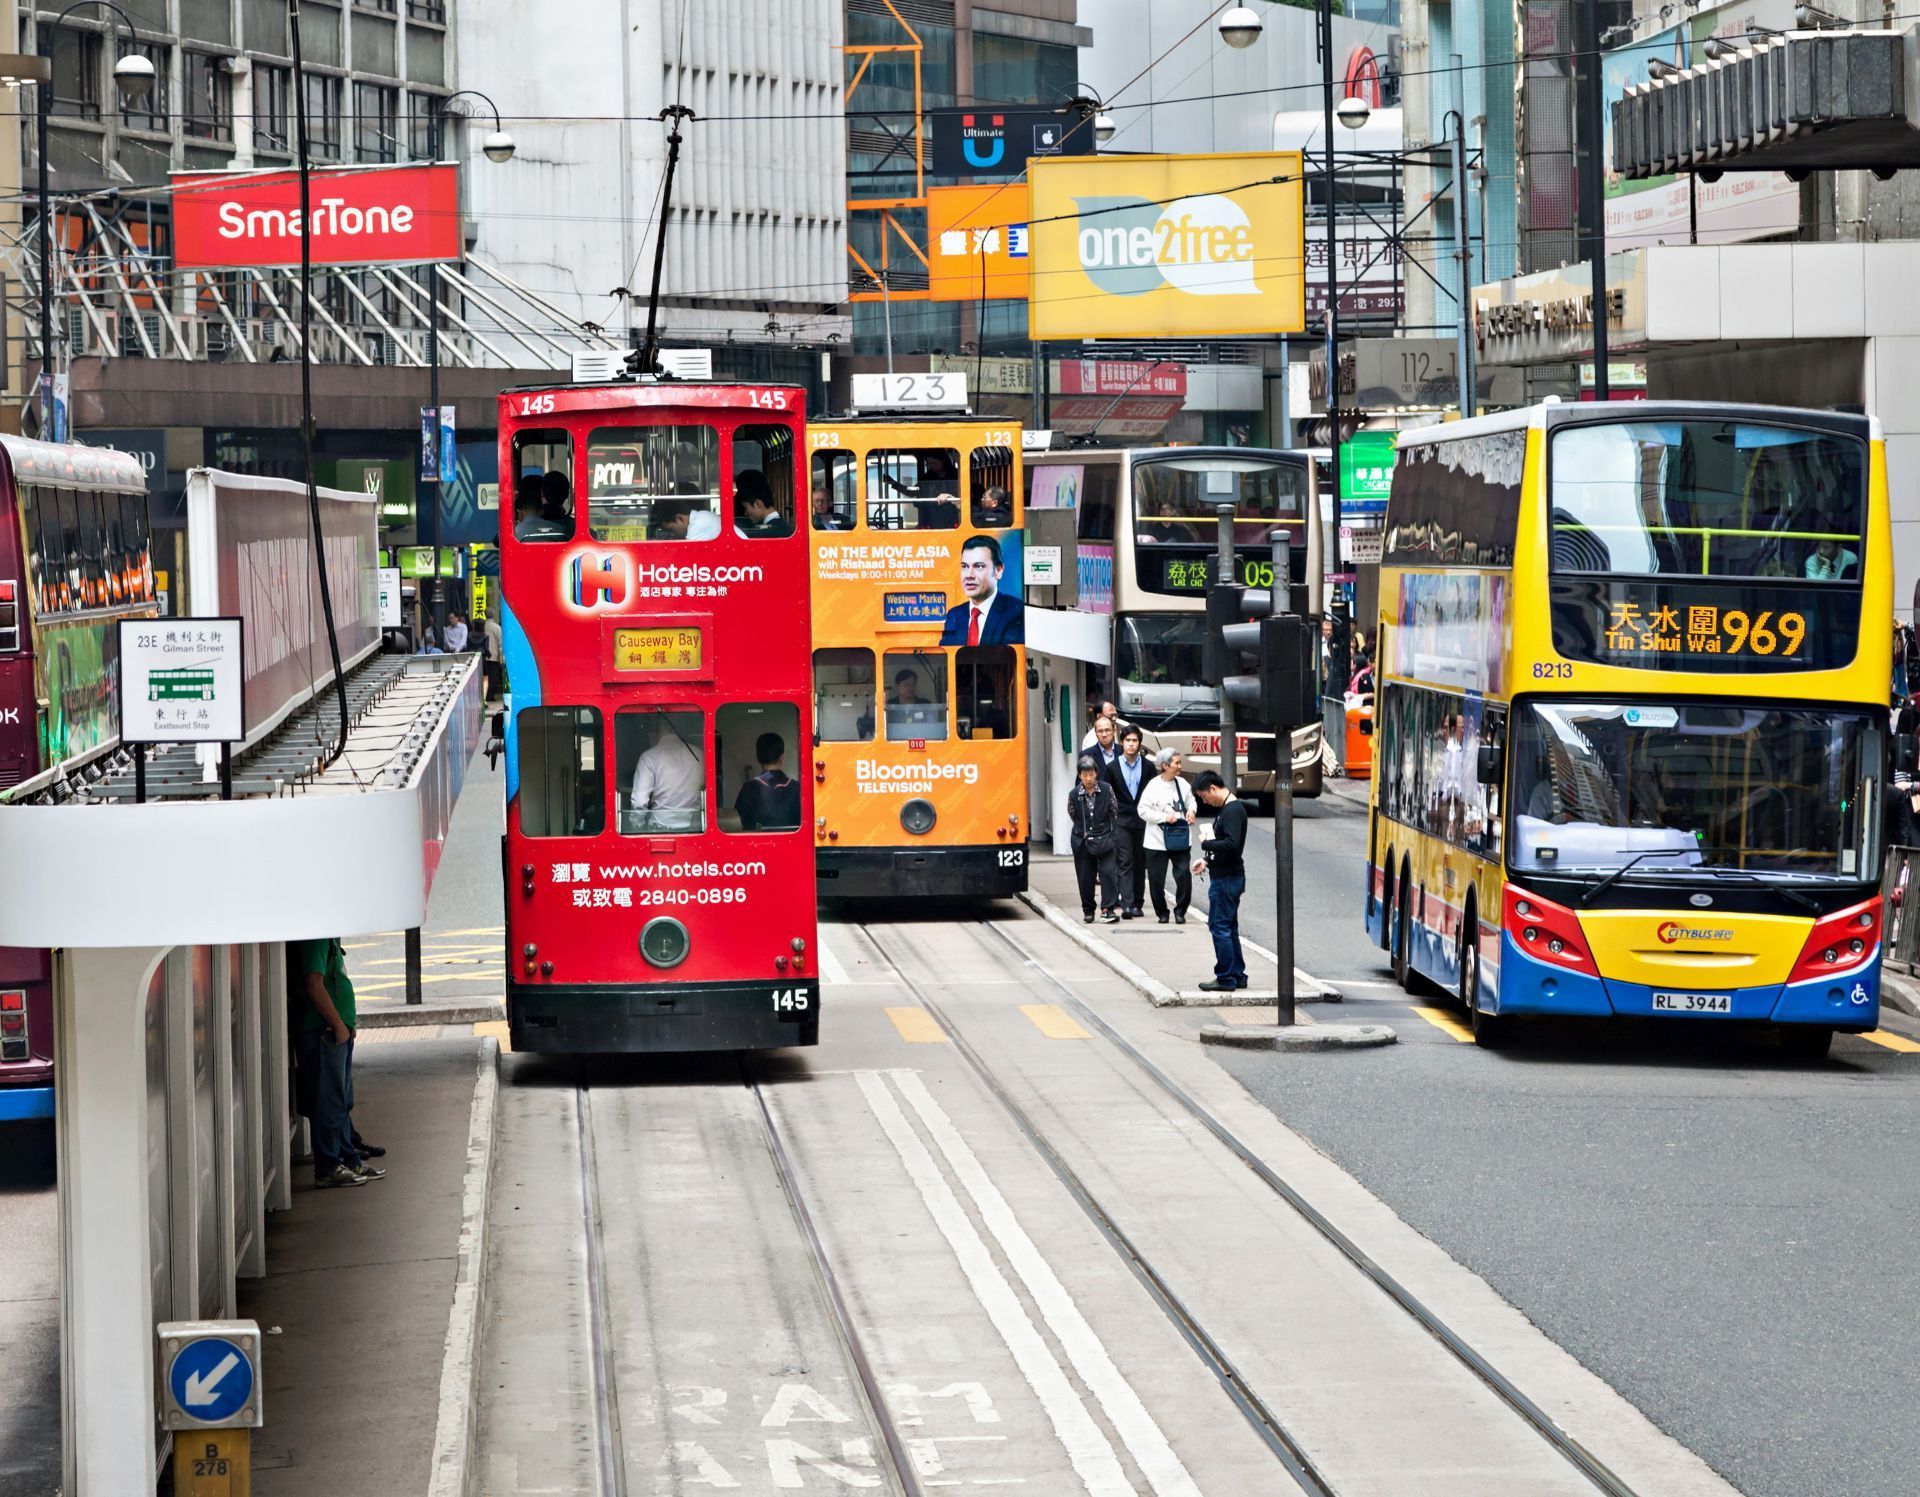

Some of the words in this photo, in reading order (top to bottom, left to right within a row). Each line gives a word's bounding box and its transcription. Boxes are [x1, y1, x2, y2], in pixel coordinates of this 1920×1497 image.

[963, 128, 1005, 138] Ultimate
[218, 198, 414, 239] SmarTone
[1079, 214, 1255, 267] one2free
[1401, 352, 1431, 383] 112
[881, 376, 946, 401] 123
[521, 395, 555, 415] 145
[749, 390, 786, 409] 145
[812, 432, 839, 447] 123
[985, 431, 1012, 446] 123
[593, 463, 635, 489] PCCW
[818, 546, 838, 559] ON
[841, 547, 868, 558] THE
[872, 546, 913, 558] MOVE
[916, 546, 950, 558] ASIA
[818, 559, 838, 570] with
[841, 559, 885, 569] Rishaad
[888, 559, 935, 568] Salamat
[639, 563, 763, 583] Hotels.com
[818, 571, 859, 580] Weekdays
[861, 570, 907, 579] 9:00-11:00
[909, 570, 924, 578] AM
[1173, 579, 1186, 587] LAI
[1190, 579, 1203, 587] CHI
[640, 587, 682, 598] 酒店專家
[686, 586, 728, 597] 專注為你
[887, 595, 916, 605] Western
[919, 594, 945, 604] Market
[1609, 603, 1718, 635] 天水圍
[166, 631, 222, 643] 機利文街
[1722, 610, 1806, 655] 969
[138, 635, 158, 648] 23E
[619, 634, 675, 649] Causeway
[679, 632, 700, 649] Bay
[1605, 631, 1635, 650] Tin
[1640, 632, 1681, 652] Shui
[1687, 634, 1721, 653] Wai
[163, 644, 194, 653] Gilman
[196, 644, 225, 653] Street
[628, 650, 691, 665] 銅鑼灣
[1533, 663, 1573, 678] 8213
[156, 708, 208, 721] 東行站
[154, 722, 191, 730] Eastbound
[193, 721, 210, 731] Stop
[856, 759, 979, 785] Bloomberg
[857, 782, 933, 793] TELEVISION
[998, 850, 1024, 867] 123
[552, 863, 591, 883] 瀏覽
[599, 861, 766, 879] www.hotels.com
[572, 887, 633, 908] 或致電
[640, 888, 747, 907] 2840-0896
[1668, 928, 1713, 939] CITYBUS
[772, 988, 809, 1011] 145
[1656, 995, 1677, 1009] RL
[1685, 996, 1728, 1010] 3944
[206, 1444, 218, 1458] B
[195, 1461, 228, 1476] 278
